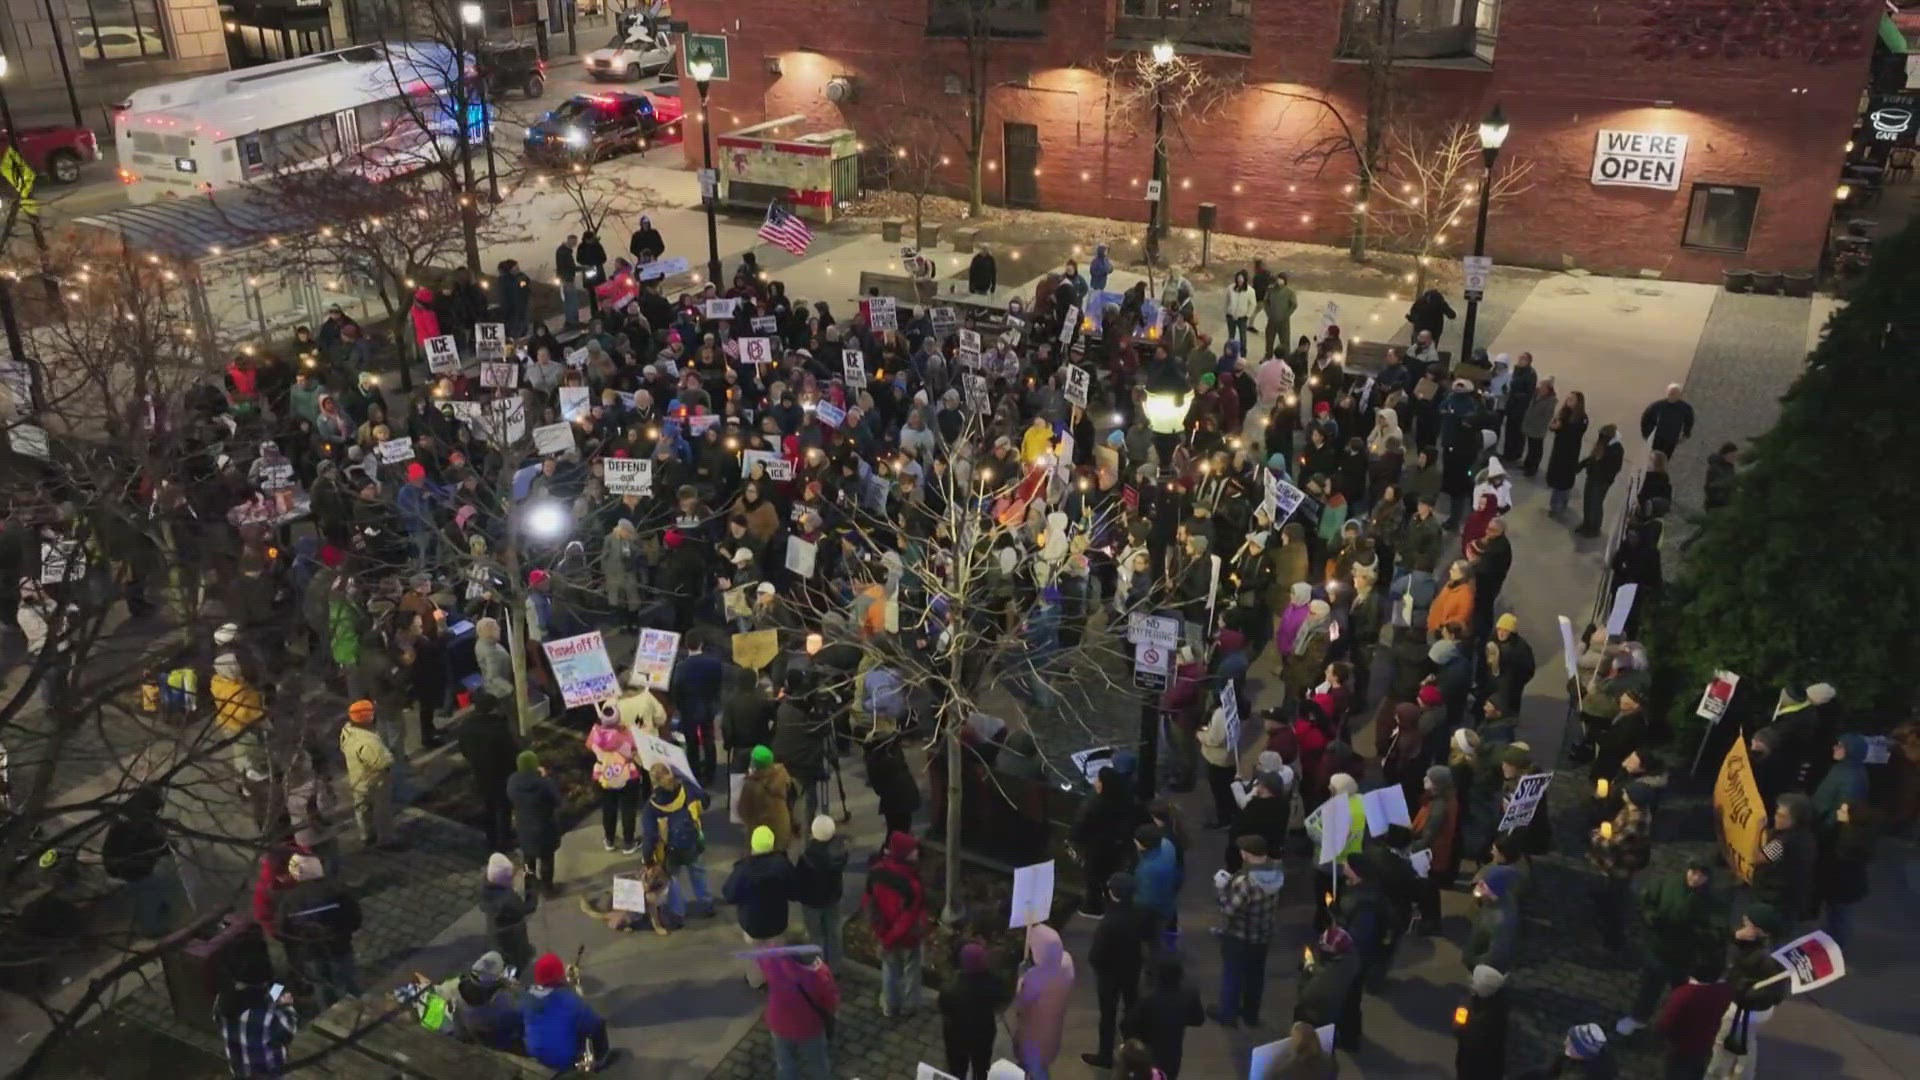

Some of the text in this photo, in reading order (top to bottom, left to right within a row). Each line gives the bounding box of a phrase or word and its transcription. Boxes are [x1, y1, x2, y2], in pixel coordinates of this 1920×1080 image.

[1608, 133, 1677, 154] WE'RE
[1875, 131, 1898, 141] CAFE
[1600, 157, 1675, 183] OPEN
[481, 325, 500, 340] ICE
[431, 337, 451, 354] ICE
[846, 352, 859, 368] ICE
[1071, 367, 1085, 387] ICE
[608, 460, 647, 472] DEFEND
[1146, 619, 1160, 630] NO
